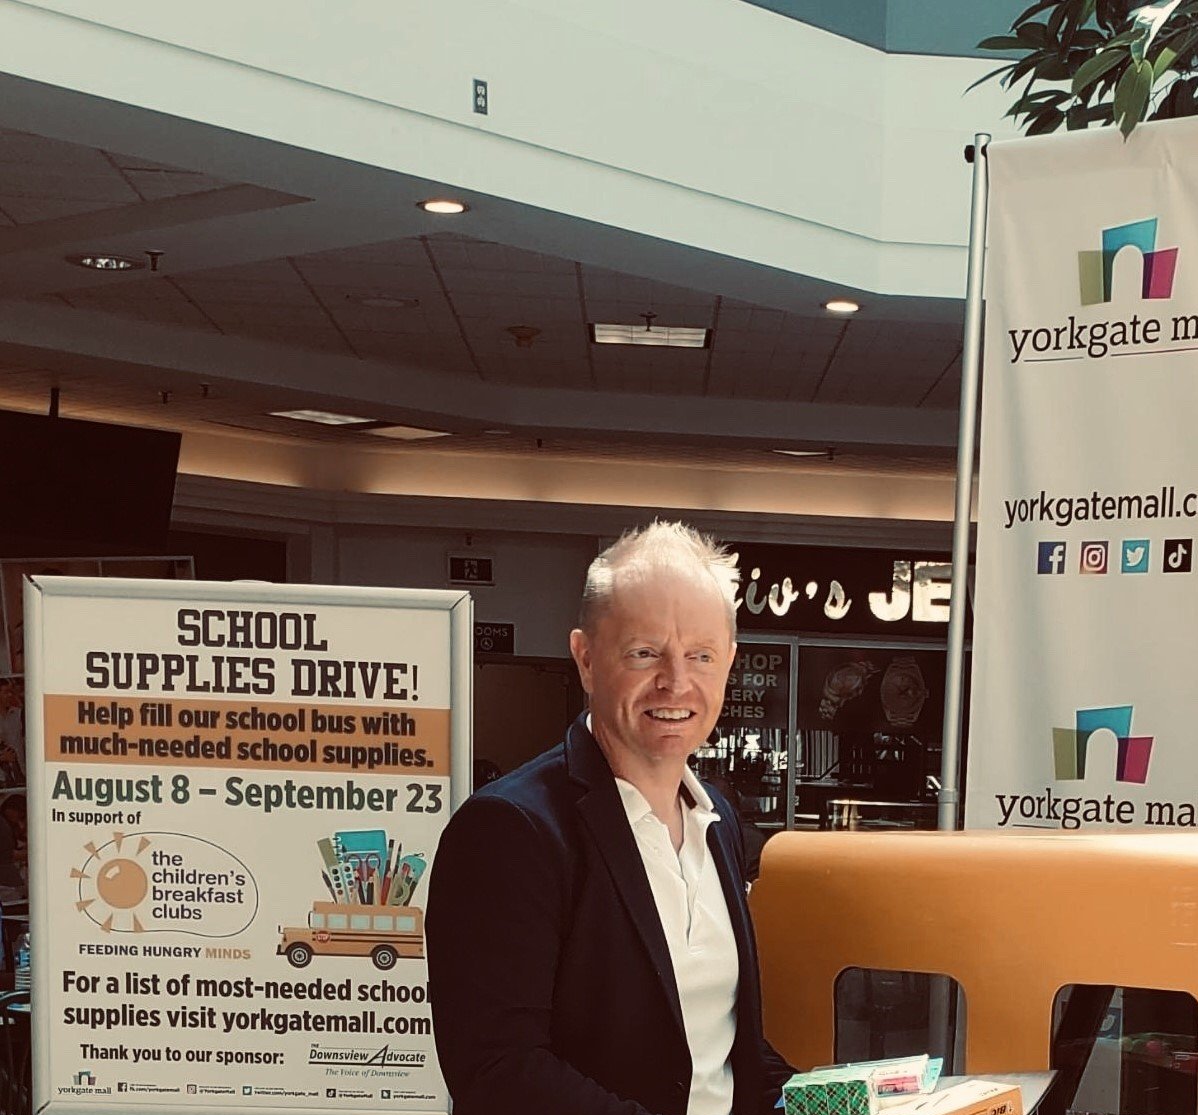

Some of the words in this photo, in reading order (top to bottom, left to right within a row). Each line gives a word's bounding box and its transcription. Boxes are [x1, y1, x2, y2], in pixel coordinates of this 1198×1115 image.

[1009, 312, 1162, 363] yorkgate
[177, 608, 329, 652] SCHOOL
[85, 651, 277, 695] SUPPLIES
[290, 657, 419, 701] DRIVE!
[743, 673, 778, 687] FOR
[727, 689, 766, 702] ERY
[78, 701, 134, 731] Help
[140, 703, 173, 729] fill
[178, 709, 220, 730] our
[225, 706, 306, 732] school
[312, 709, 356, 734] bus
[362, 710, 416, 737] with
[60, 733, 231, 760] much-needed
[237, 736, 317, 763] school
[323, 739, 434, 769] supplies.
[52, 770, 163, 807] August
[171, 775, 190, 803] 8
[225, 777, 398, 812] September
[406, 783, 443, 814] 23
[52, 808, 66, 823] In
[68, 809, 125, 826] support
[127, 810, 141, 825] of
[995, 787, 1135, 830] yorkgate
[151, 850, 183, 867] the
[151, 868, 246, 887] children's
[152, 886, 244, 904] breakfast
[152, 904, 203, 920] clubs
[79, 944, 139, 957] FEEDING
[142, 945, 202, 959] HUNGRY
[205, 948, 251, 960] MINDS
[62, 971, 101, 994] For
[106, 977, 119, 995] a
[125, 971, 159, 996] list
[165, 973, 191, 997] of
[197, 974, 352, 1001] most-needed
[358, 980, 431, 1003] school
[63, 1004, 161, 1031] supplies
[167, 1005, 217, 1029] visit
[222, 1008, 431, 1036] yorkgatemall.com
[80, 1044, 129, 1060] Thank
[133, 1048, 161, 1063] you
[166, 1047, 182, 1062] to
[186, 1049, 212, 1063] our
[216, 1049, 284, 1065] sponsor:
[309, 1049, 369, 1061] Downsview
[367, 1044, 426, 1068] Advocate
